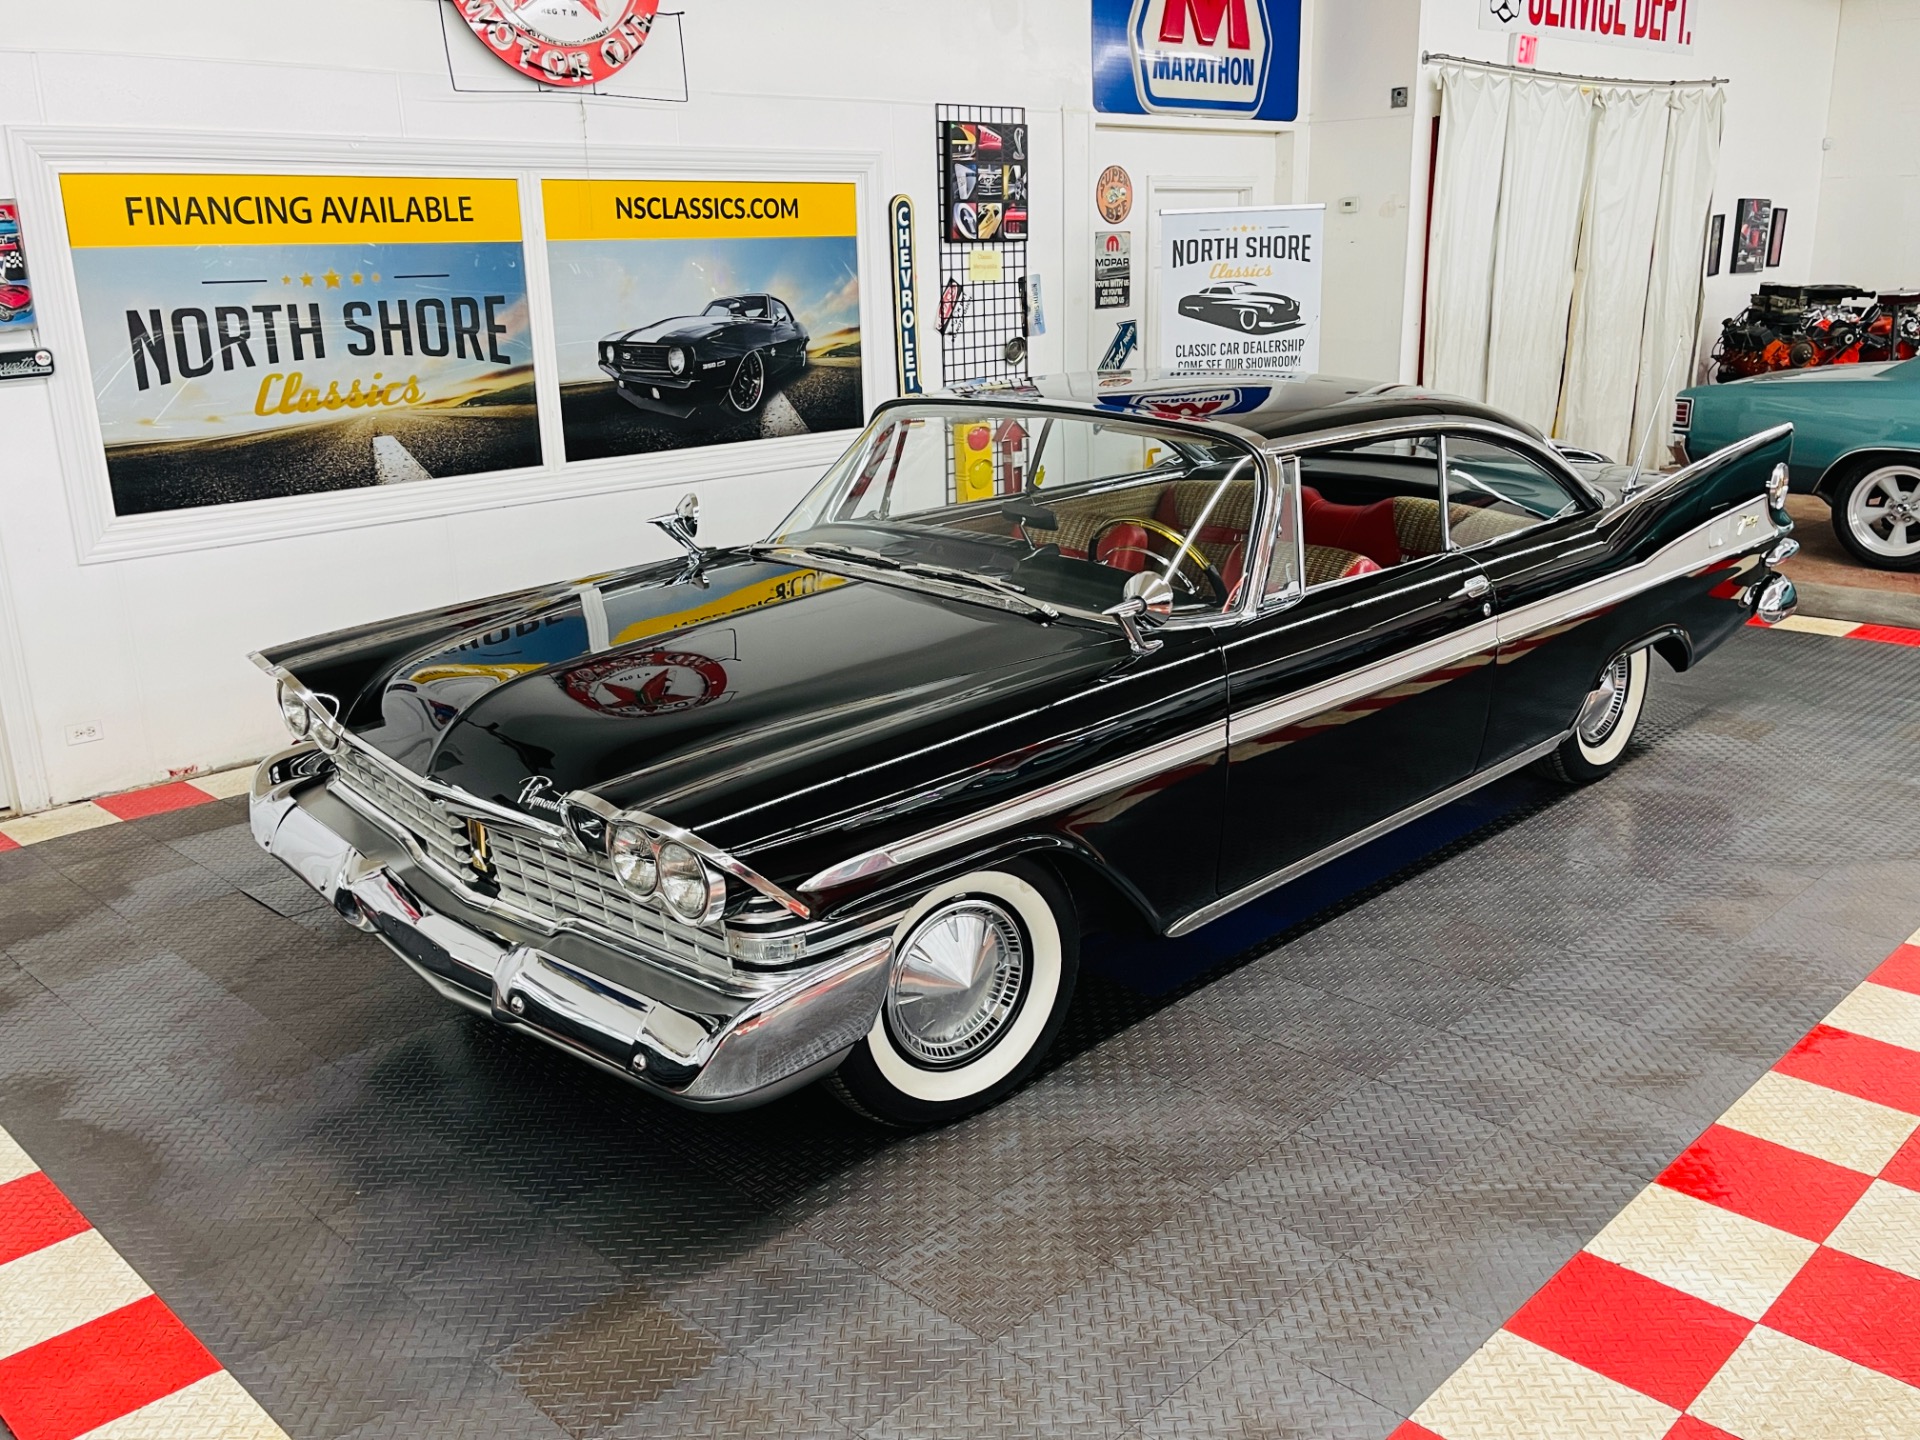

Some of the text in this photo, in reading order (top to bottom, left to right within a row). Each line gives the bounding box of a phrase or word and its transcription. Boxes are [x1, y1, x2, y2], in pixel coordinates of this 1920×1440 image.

[456, 0, 594, 82] MOTOR
[1518, 35, 1538, 65] EXIT
[1152, 53, 1254, 86] MARATHON
[1100, 168, 1129, 198] SUPER
[125, 194, 474, 227] FINANCING AVAILABLE
[616, 196, 799, 220] NSCLASSICS.COM
[1105, 200, 1128, 221] BEE
[1095, 257, 1129, 267] MOPAR
[1172, 233, 1312, 269] NORTH SHORE
[1110, 279, 1123, 288] WITH
[1209, 262, 1274, 280] Classics
[897, 207, 917, 391] CHEVROLET
[1099, 296, 1119, 306] BEHIND
[126, 294, 511, 391] NORTH SHORE
[1175, 338, 1305, 358] CLASSIC CAR DEALERSHIP
[1177, 359, 1203, 369] COME
[1206, 358, 1223, 369] SEE
[1225, 357, 1244, 369] OUR
[254, 370, 426, 417] Classics
[517, 775, 568, 813] Plymout
